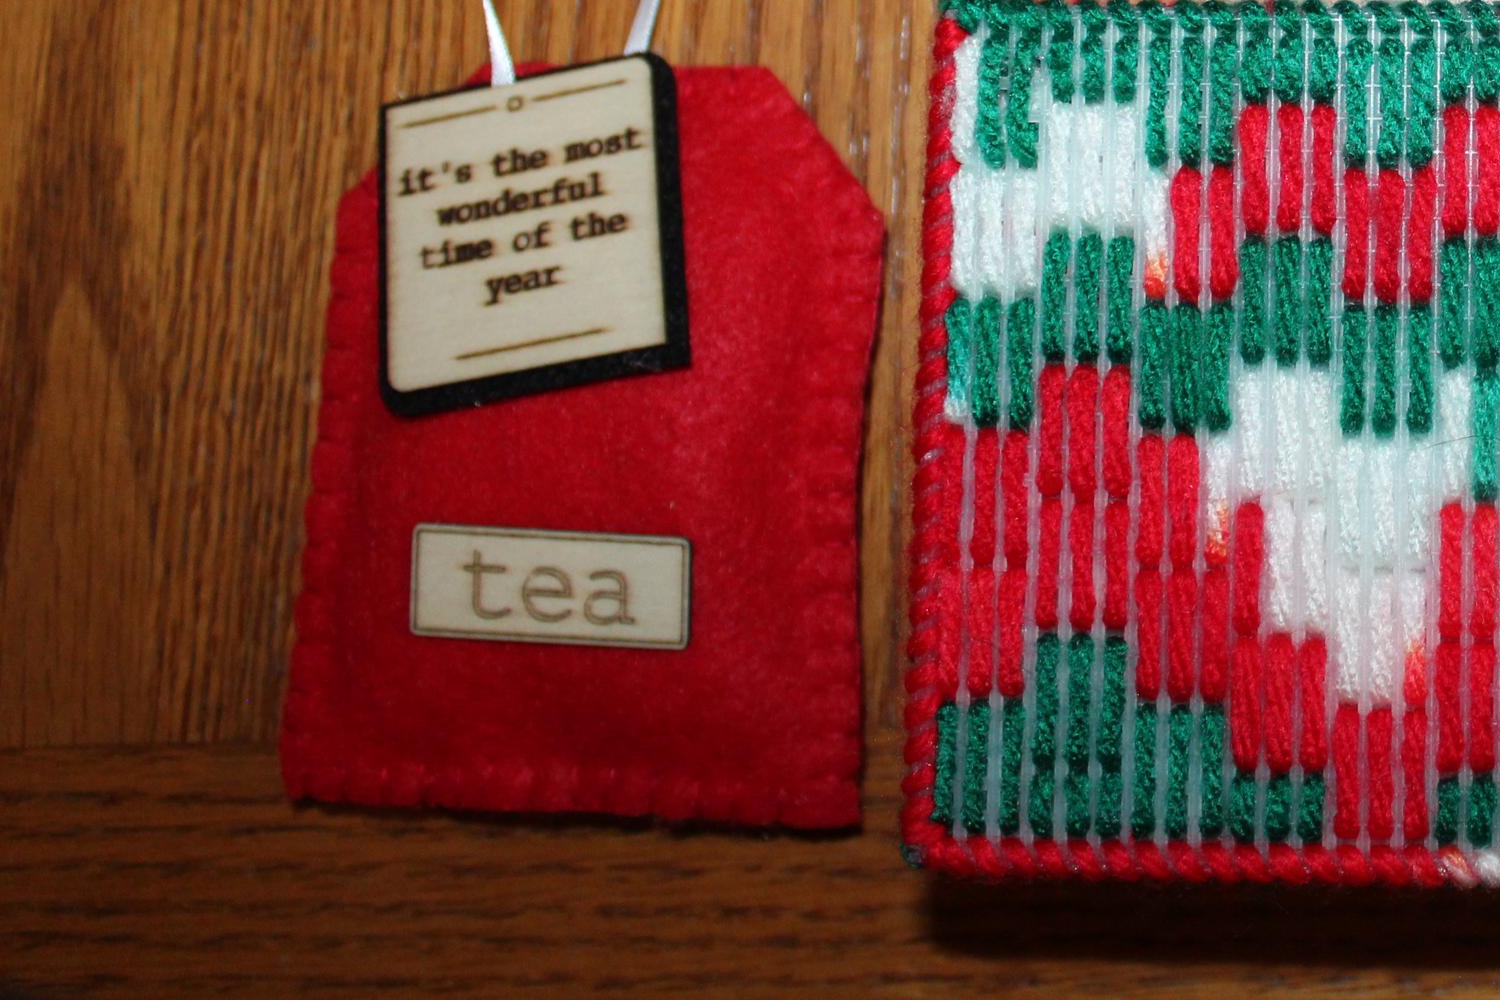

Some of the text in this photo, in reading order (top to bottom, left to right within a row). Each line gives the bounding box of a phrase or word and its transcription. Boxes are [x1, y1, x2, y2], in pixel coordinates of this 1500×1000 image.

[398, 127, 645, 196] it's the most
[437, 172, 605, 226] wonderful
[421, 212, 628, 269] time of the
[484, 264, 563, 307] year
[462, 549, 635, 626] tea
